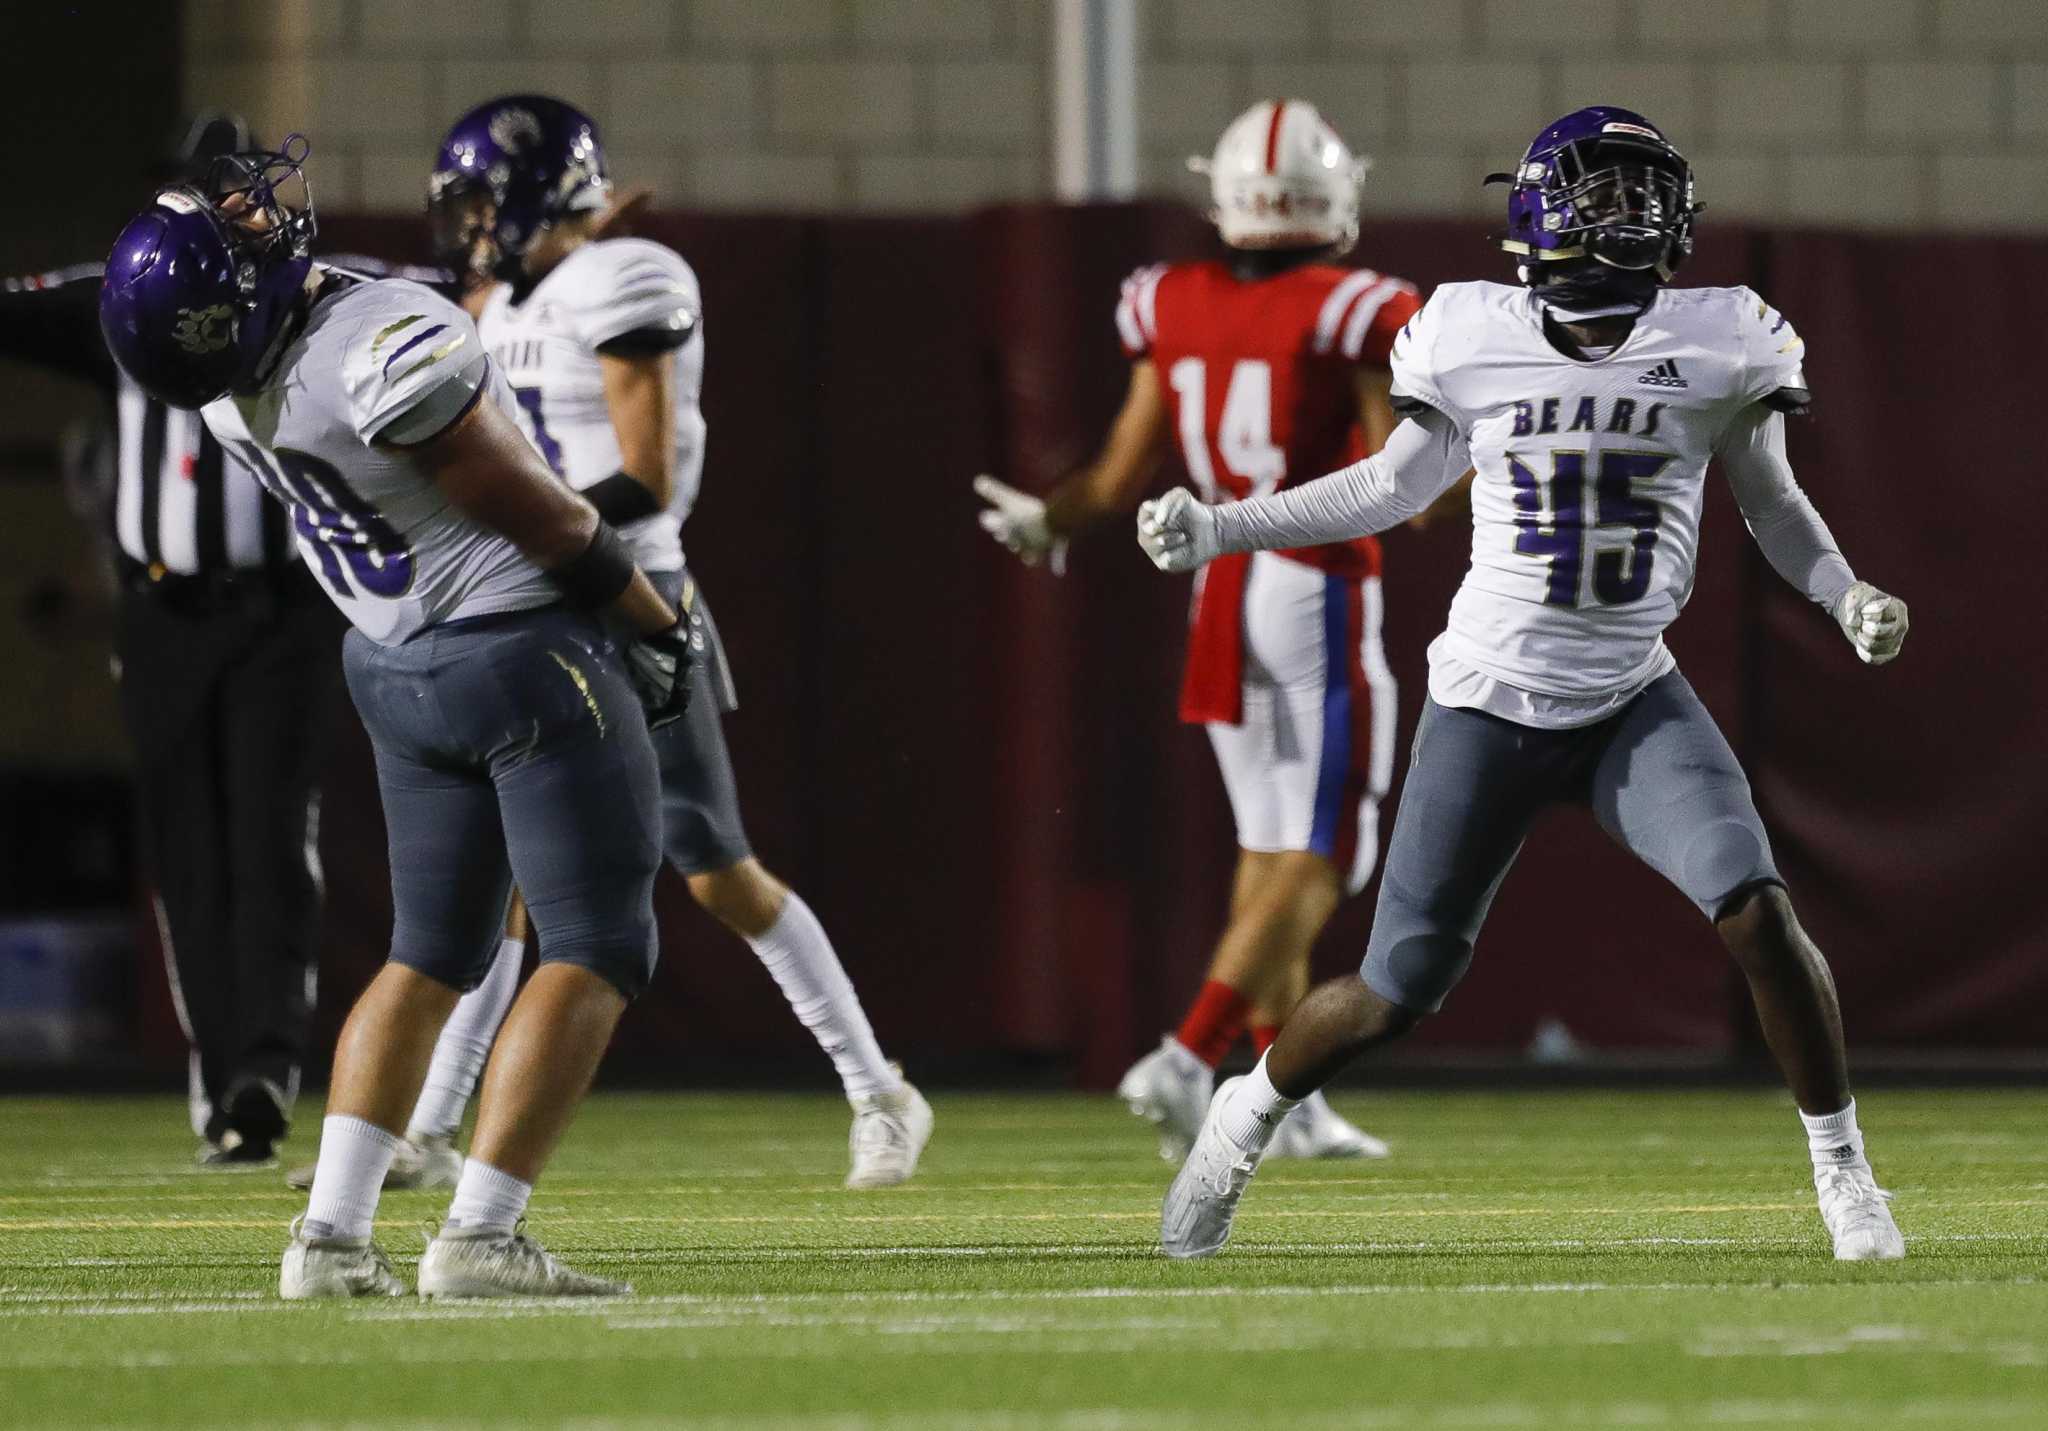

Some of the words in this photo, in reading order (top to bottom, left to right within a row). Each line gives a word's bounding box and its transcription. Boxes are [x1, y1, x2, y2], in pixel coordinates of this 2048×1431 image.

[1169, 357, 1287, 505] 14
[1509, 395, 1671, 437] BEARS
[1503, 448, 1680, 609] 45
